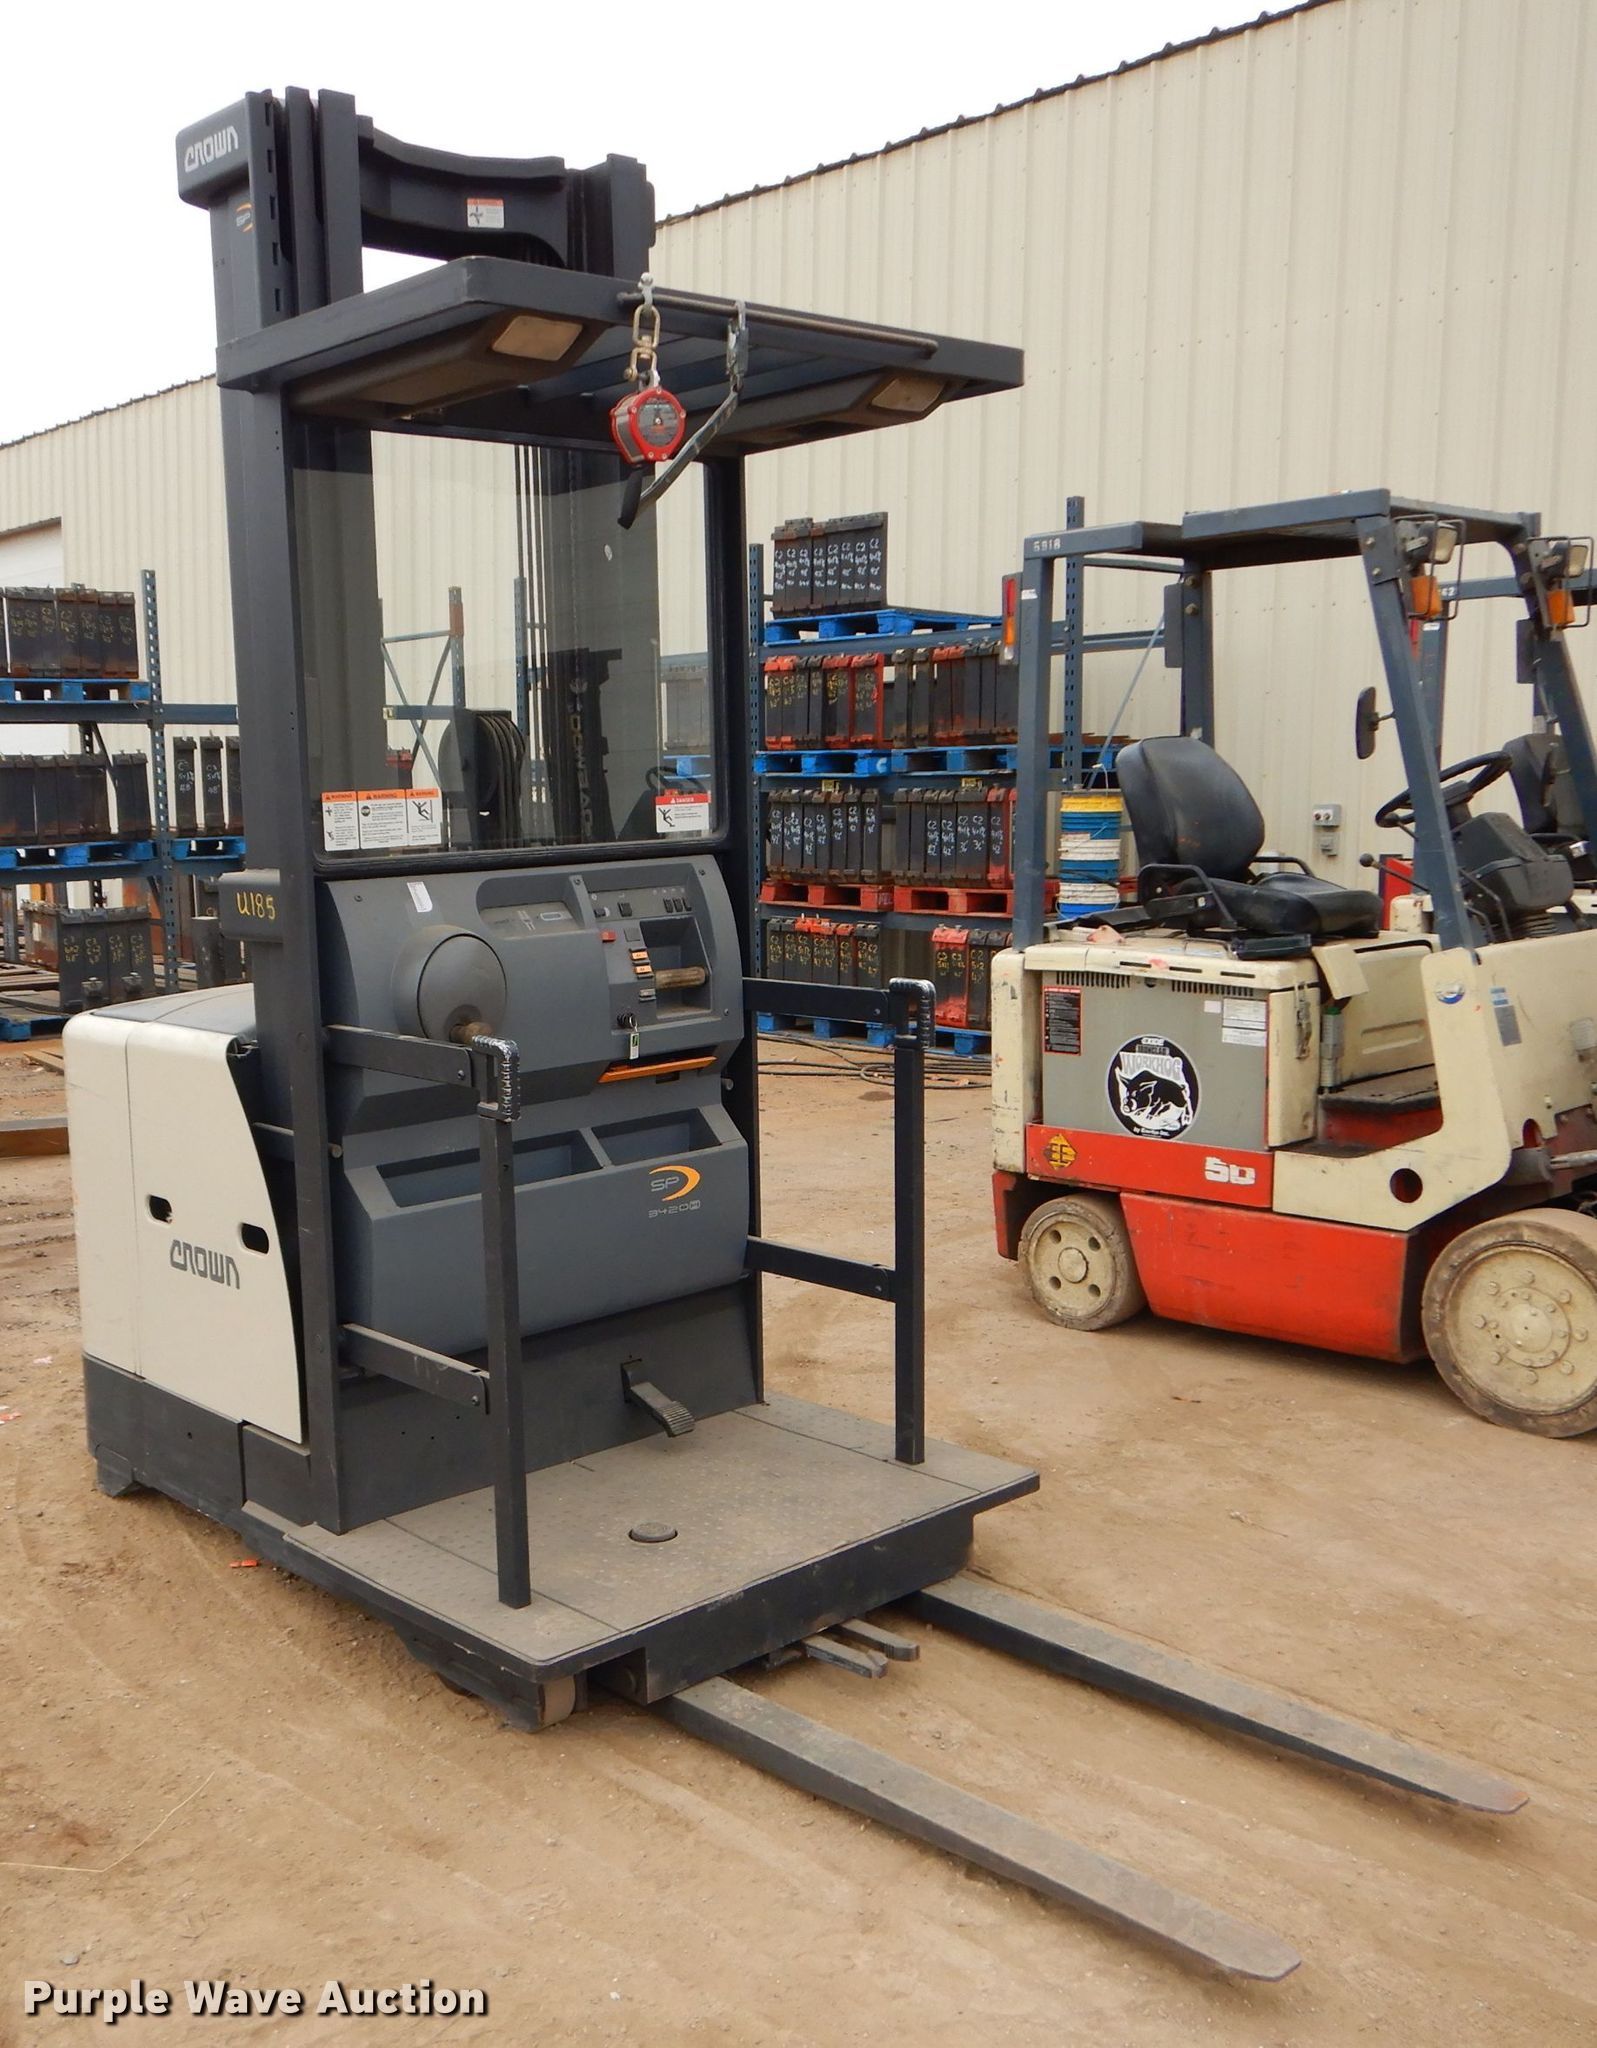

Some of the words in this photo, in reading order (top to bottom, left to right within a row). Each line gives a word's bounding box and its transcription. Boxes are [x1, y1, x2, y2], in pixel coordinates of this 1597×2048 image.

[184, 125, 238, 173] CROWN
[1121, 1053, 1181, 1079] WORKHOG
[650, 1176, 680, 1192] SP
[169, 1239, 240, 1290] CROWN
